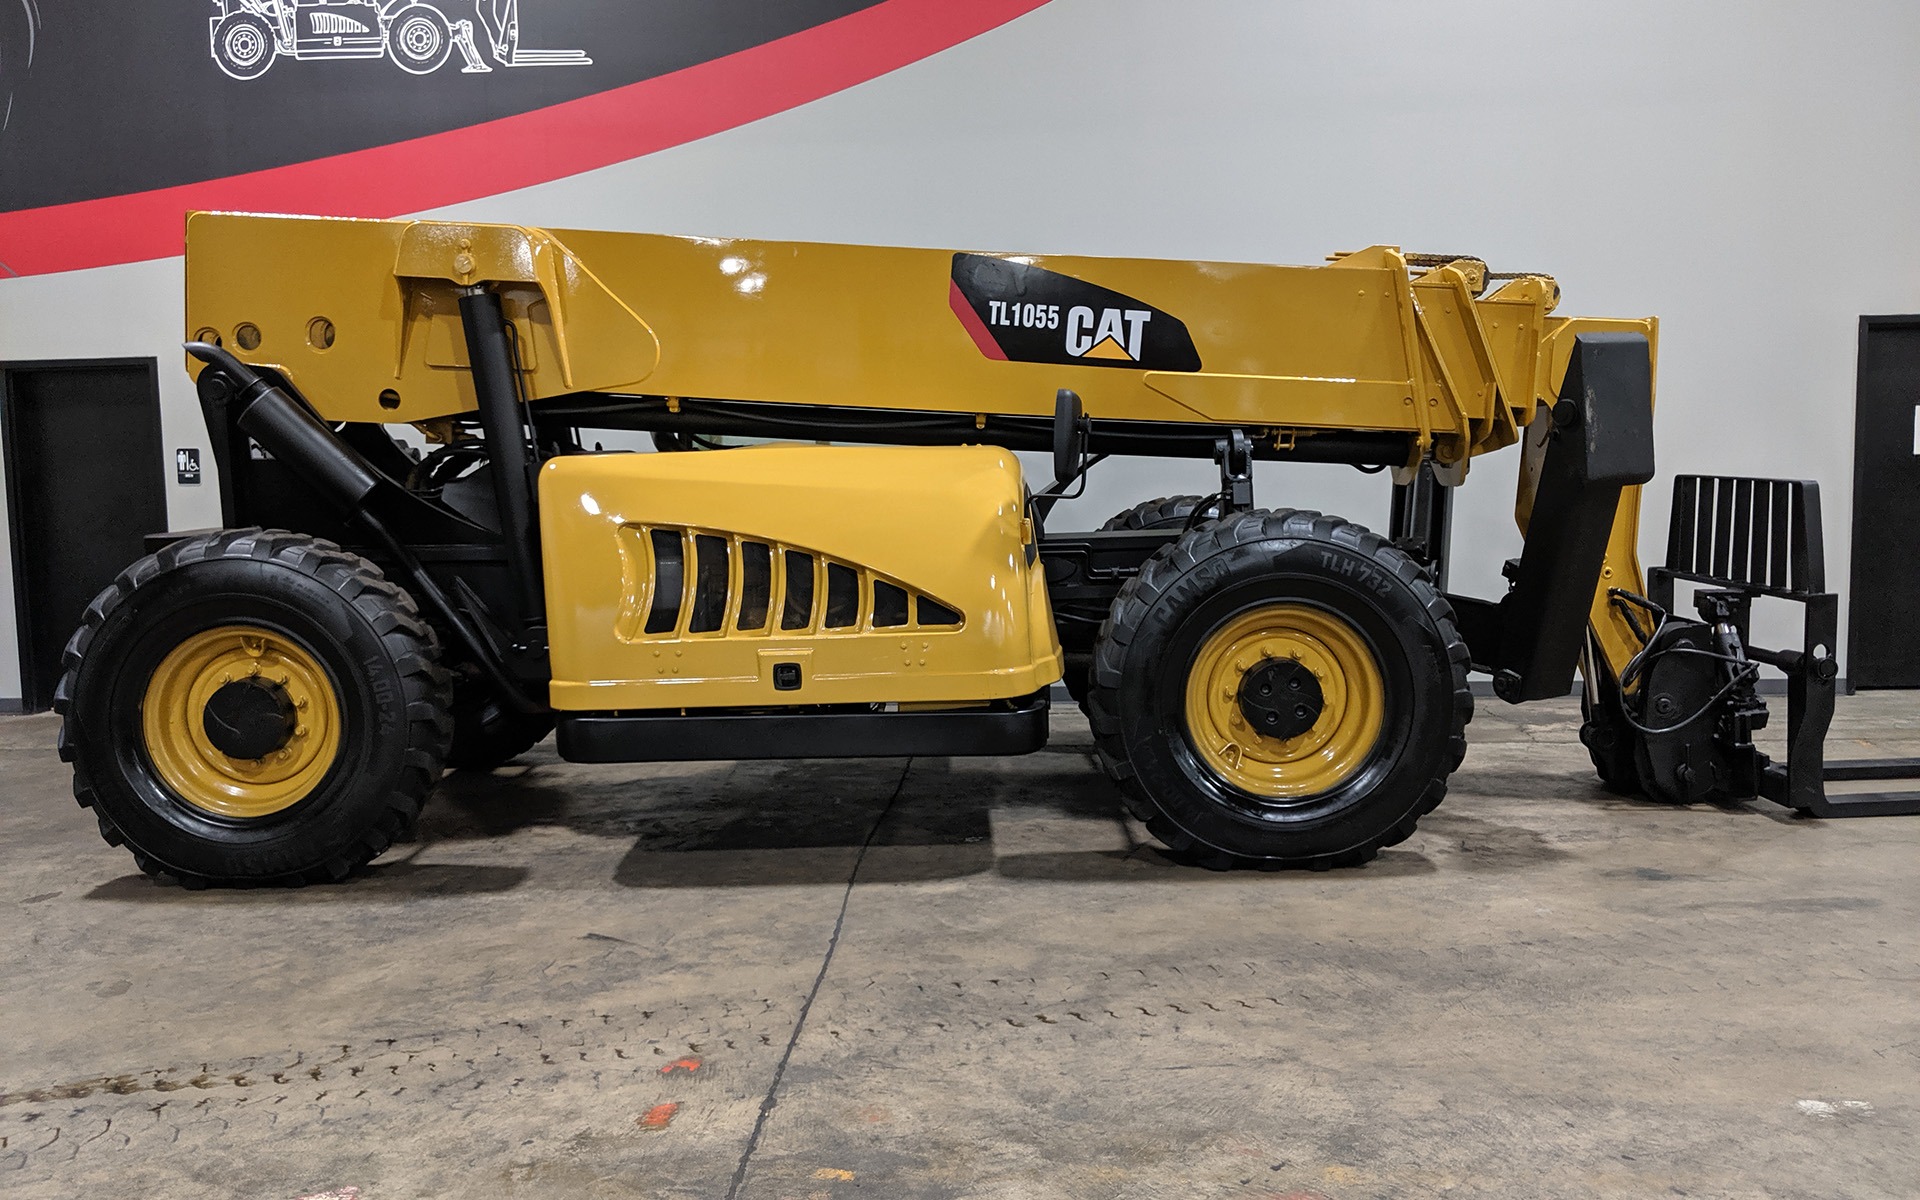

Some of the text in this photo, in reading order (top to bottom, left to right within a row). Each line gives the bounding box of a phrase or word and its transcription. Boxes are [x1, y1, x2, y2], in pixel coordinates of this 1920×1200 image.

[988, 300, 1152, 362] TL1055 CAT
[1320, 551, 1394, 599] TLH 732
